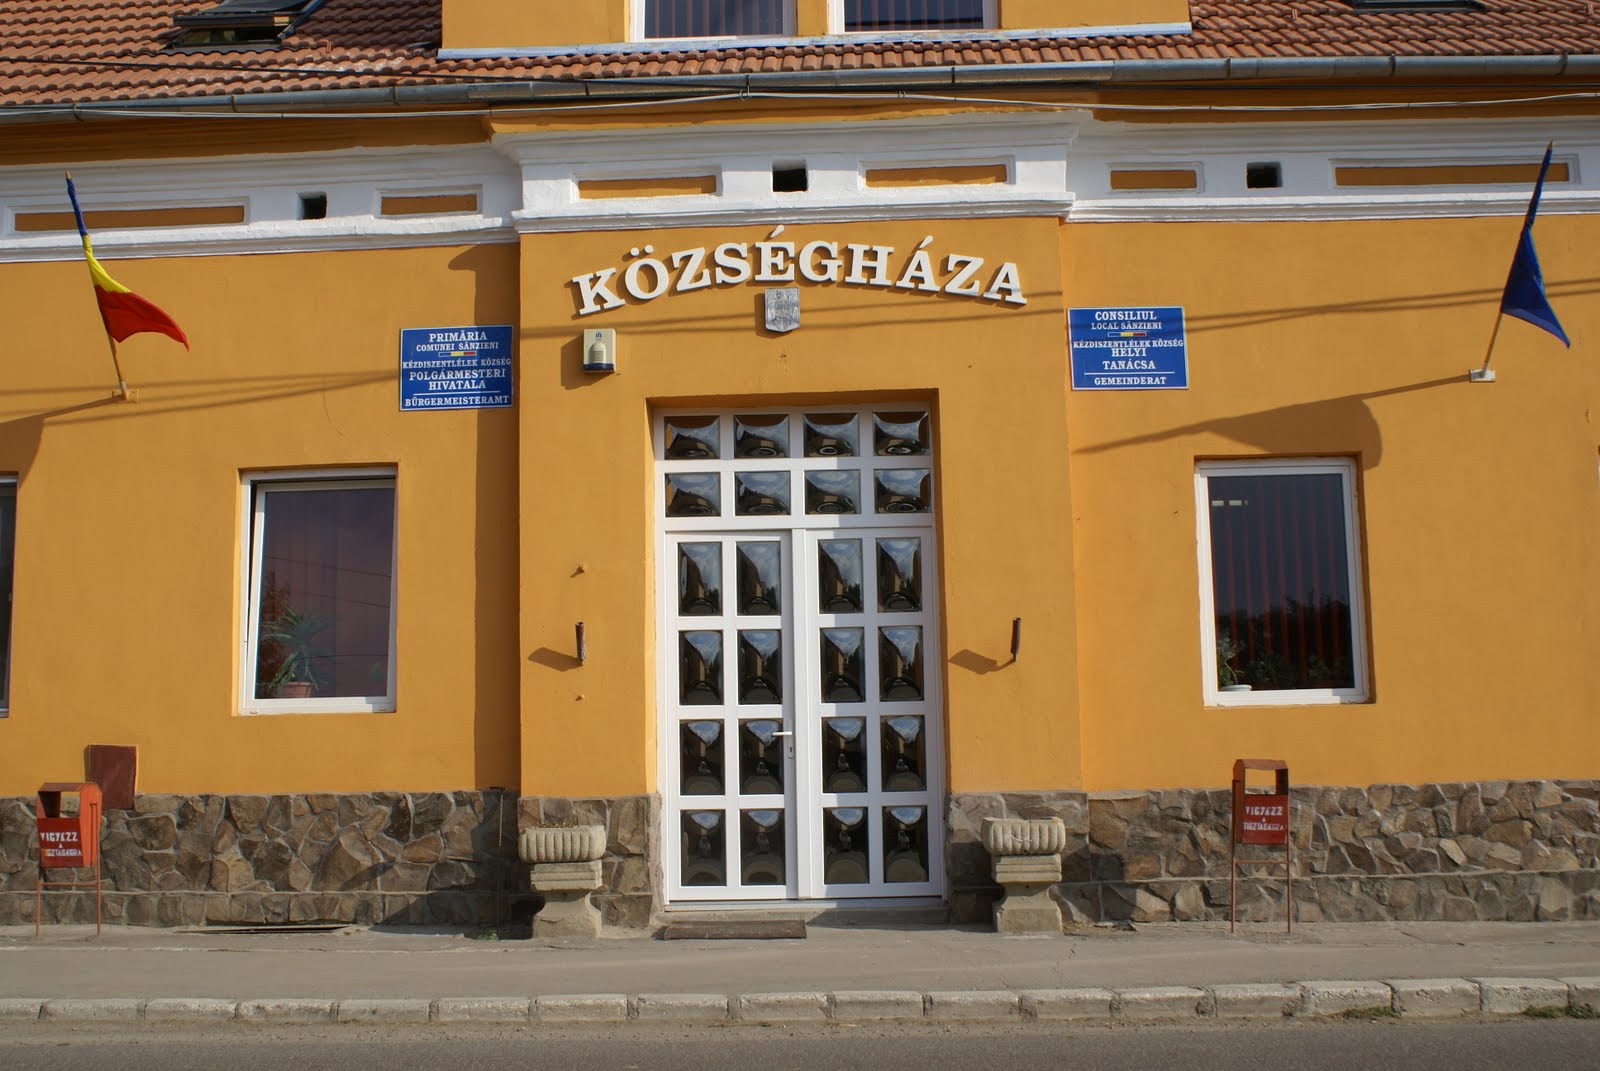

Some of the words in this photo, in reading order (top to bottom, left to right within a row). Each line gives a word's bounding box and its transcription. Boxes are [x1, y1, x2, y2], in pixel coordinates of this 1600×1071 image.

[572, 225, 1028, 315] KÖZSÉGHÁZA
[1095, 311, 1157, 321] CONSILIUL
[1091, 322, 1119, 330] LOCAL
[429, 330, 487, 343] PRIMĂRIA
[416, 343, 455, 352] COMUNEI
[1073, 339, 1150, 348] KÉZDISZENTLÉLEK
[1152, 338, 1184, 348] KÖZSÉG
[1111, 347, 1147, 357] HELYI
[402, 359, 478, 369] KÉZDISZENTLÉLEK
[480, 357, 511, 367] KÖZSÉG
[1102, 358, 1156, 370] TANÁCSA
[409, 368, 506, 381] POLGÁRMESTERI
[428, 380, 486, 391] HIVATALA
[1094, 376, 1166, 386] GEMEINDERAT
[405, 395, 509, 407] BÜRGERMEISTERAMT
